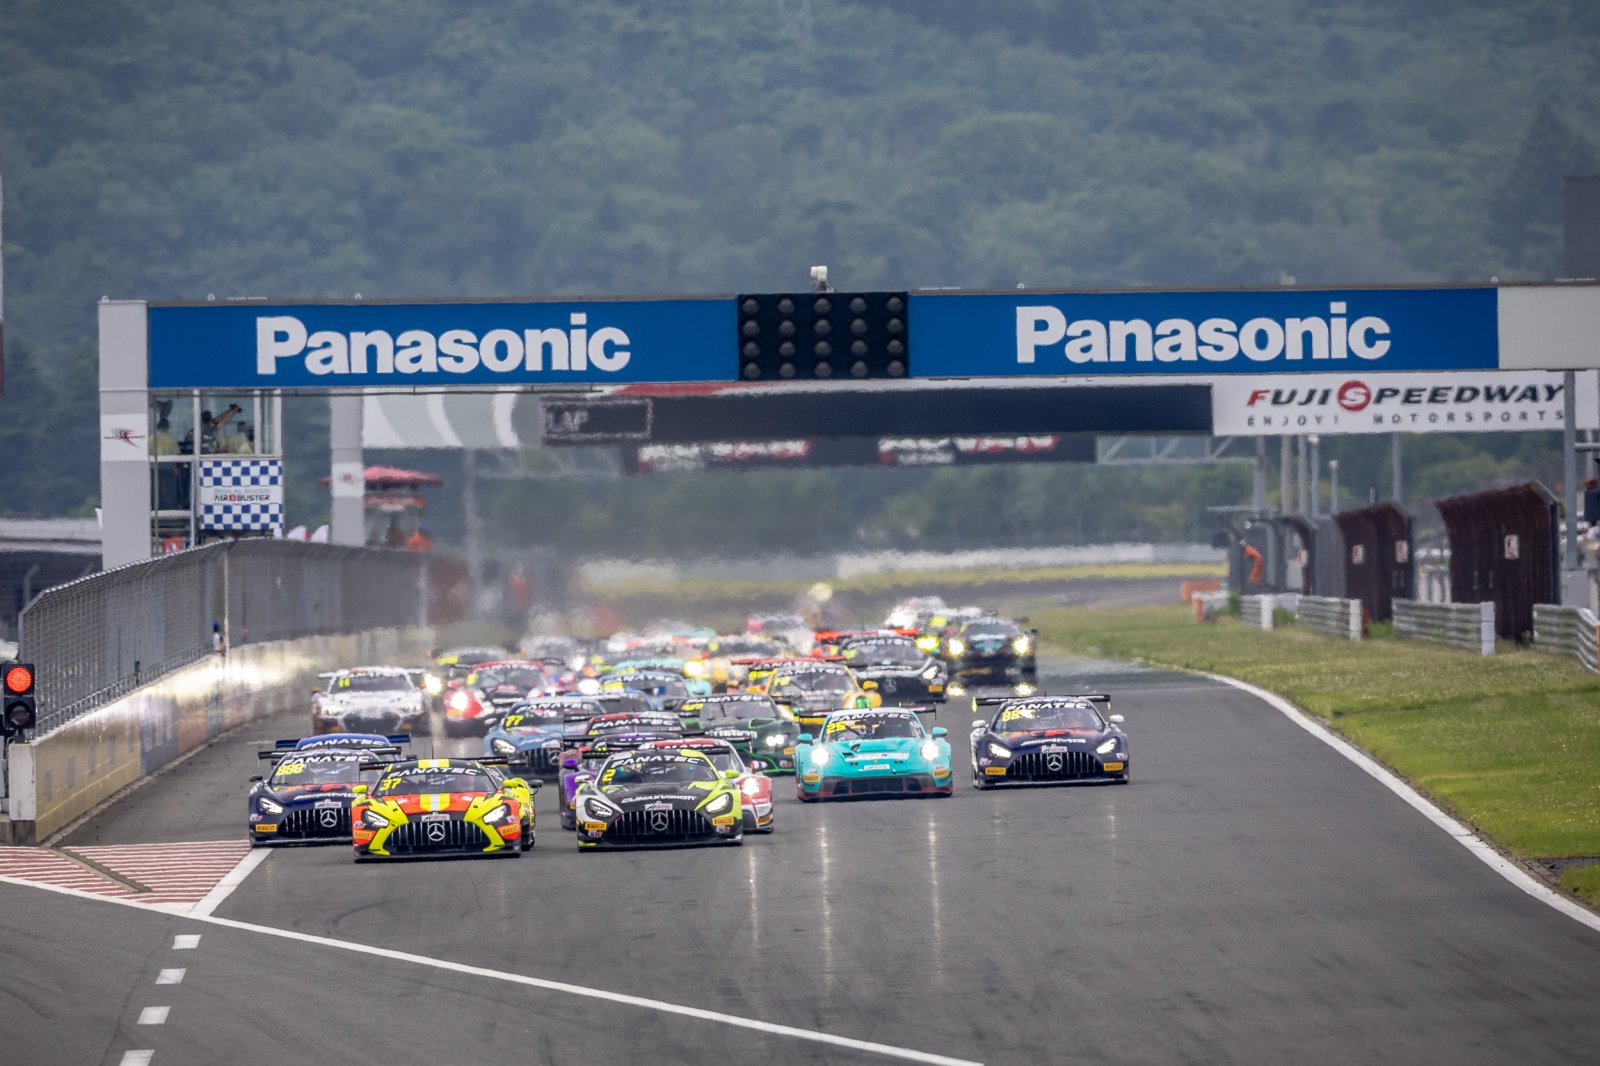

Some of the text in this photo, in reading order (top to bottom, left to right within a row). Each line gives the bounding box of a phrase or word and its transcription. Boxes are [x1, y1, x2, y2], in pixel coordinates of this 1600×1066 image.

[1015, 301, 1391, 364] Panasonic
[255, 312, 631, 376] Panasonic
[1247, 380, 1564, 412] FUJI SPEEDWAY
[1247, 410, 1564, 427] ENJOY! MOTORSPORTS
[686, 695, 764, 704] FANATEC
[515, 703, 594, 714] FANATEC
[1004, 702, 1088, 712] FANATEC
[593, 718, 676, 729] FANATEC
[829, 712, 912, 723] FANATEC
[825, 721, 846, 735] 25
[301, 739, 385, 750] FANATEC
[281, 755, 369, 765] FANATEC
[610, 755, 701, 768] FANATEC
[275, 763, 304, 776] 888
[387, 767, 477, 779] FANATEC
[601, 769, 616, 782] 2
[379, 777, 402, 791] 37
